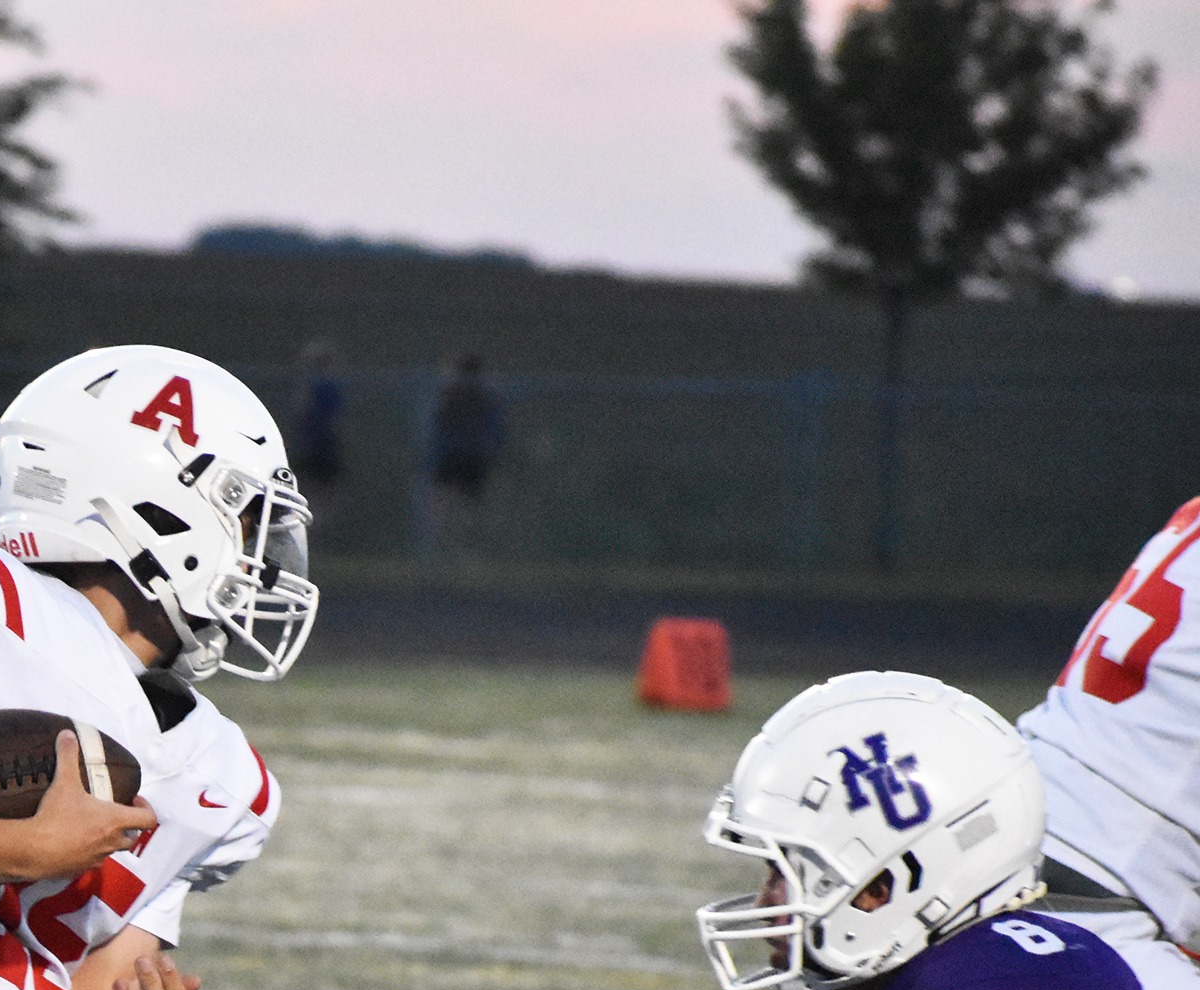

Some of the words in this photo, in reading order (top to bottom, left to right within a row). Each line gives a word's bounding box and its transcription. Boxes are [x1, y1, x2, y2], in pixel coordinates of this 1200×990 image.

[130, 375, 200, 448] A
[827, 731, 933, 832] NU
[991, 919, 1066, 956] 8
